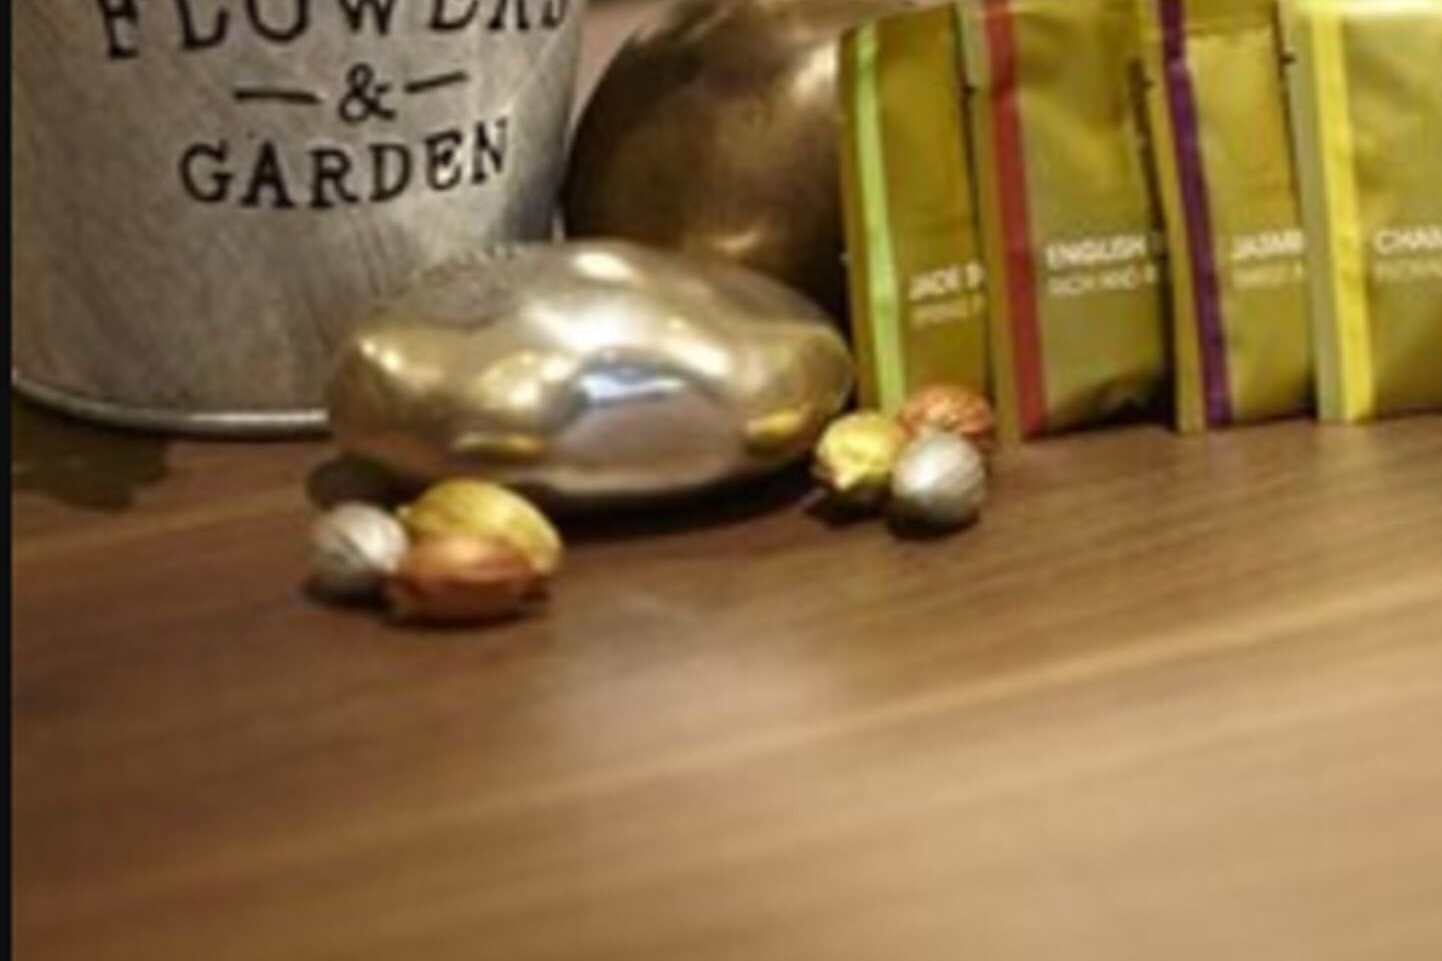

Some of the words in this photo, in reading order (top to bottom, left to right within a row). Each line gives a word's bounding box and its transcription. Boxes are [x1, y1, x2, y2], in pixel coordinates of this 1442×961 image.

[338, 62, 396, 124] &
[180, 118, 509, 209] GARDEN
[1045, 235, 1147, 270] ENGLISH
